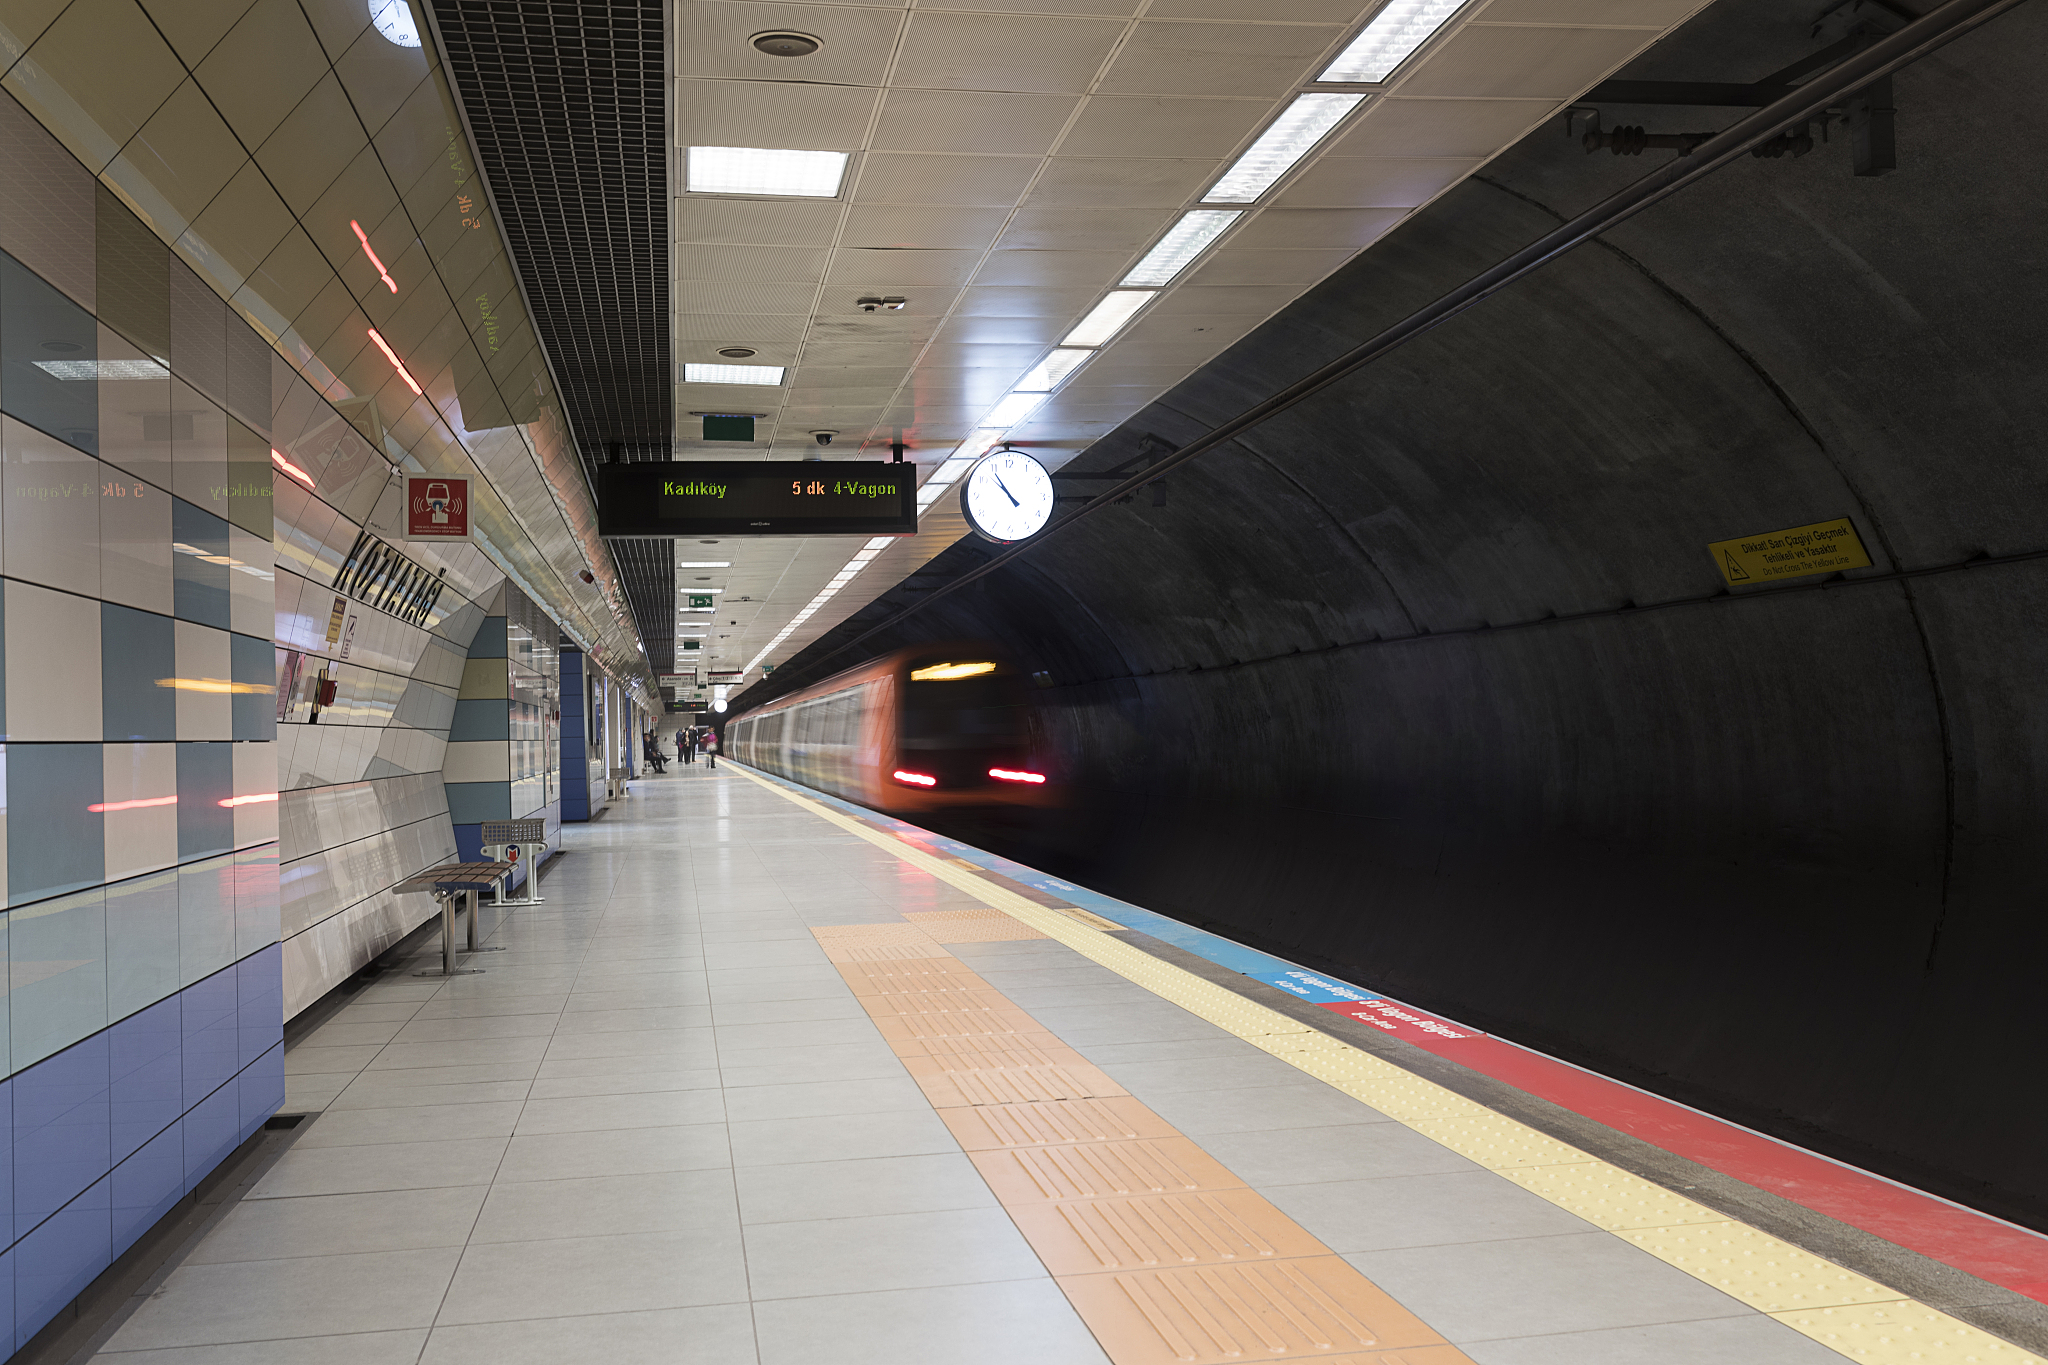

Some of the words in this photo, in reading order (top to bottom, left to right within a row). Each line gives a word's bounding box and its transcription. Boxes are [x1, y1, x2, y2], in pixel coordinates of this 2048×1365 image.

[664, 481, 727, 499] Kadıköy
[792, 481, 801, 495] 5
[806, 481, 825, 495] dk
[833, 481, 896, 498] 4-Vagon
[1741, 540, 1769, 554] Dikkat!
[1768, 539, 1785, 549] Sarı
[1785, 532, 1814, 549] Çizgiyi
[1813, 526, 1850, 542] Geçmek
[1763, 549, 1795, 564] Tehlikeli
[1795, 551, 1805, 559] ve
[1804, 543, 1838, 557] Yasaktır
[1763, 567, 1772, 576] Do
[1772, 565, 1785, 575] Not
[1784, 563, 1801, 574] Cross
[1800, 561, 1813, 571] The
[1812, 557, 1836, 569] Yellow
[1835, 555, 1850, 565] Line
